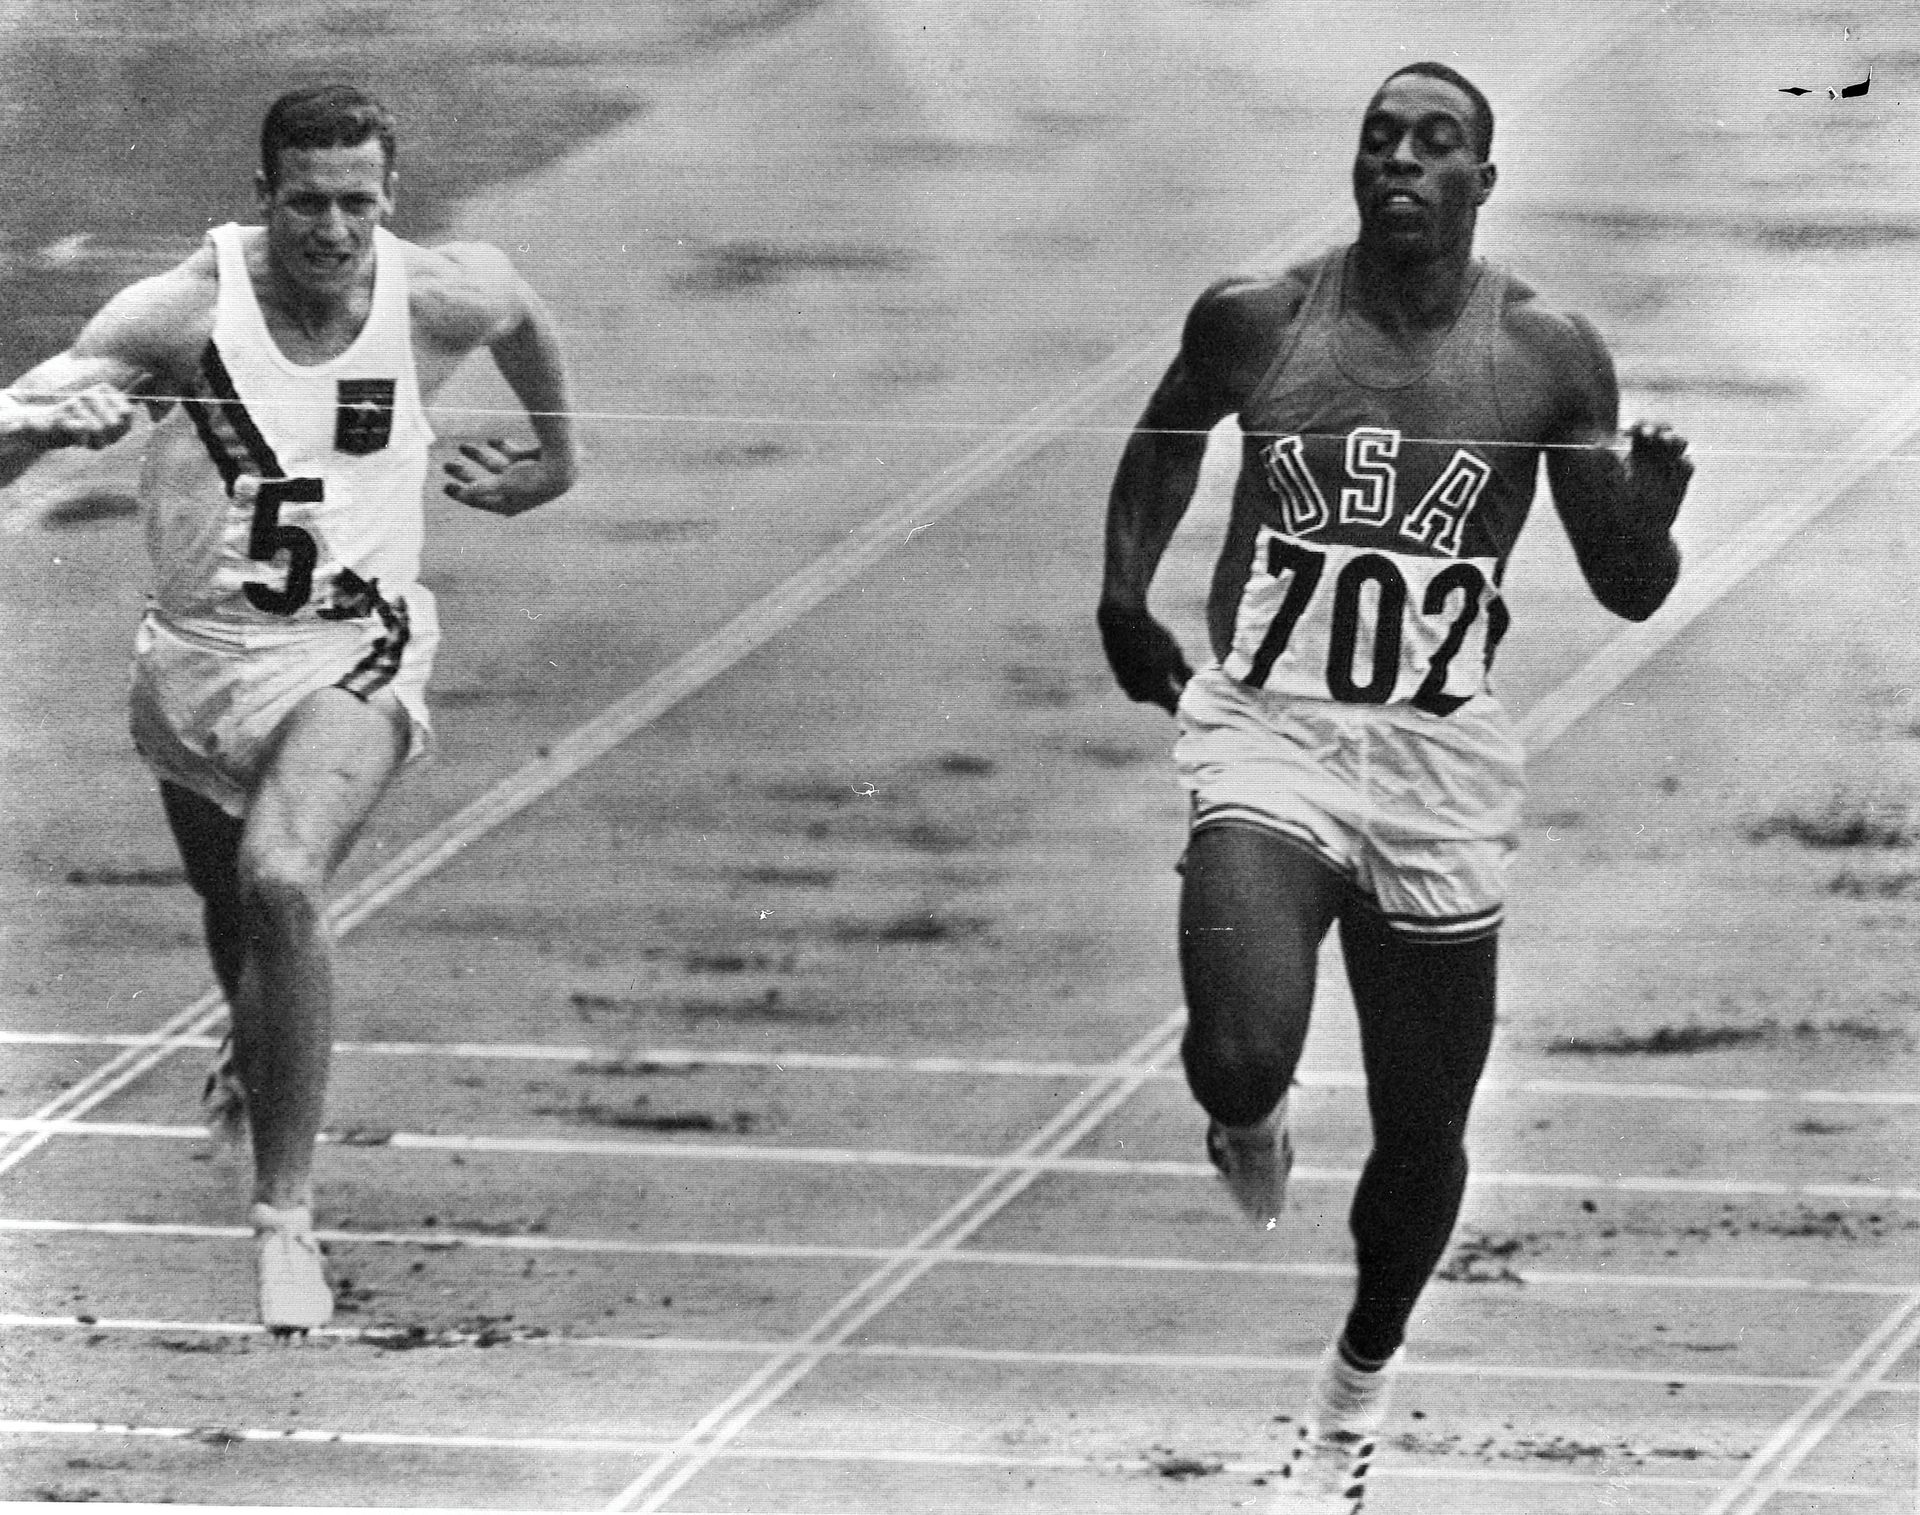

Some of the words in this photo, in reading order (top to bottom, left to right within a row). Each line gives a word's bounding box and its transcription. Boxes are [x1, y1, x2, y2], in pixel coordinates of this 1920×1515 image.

[243, 478, 324, 616] 5
[1263, 427, 1491, 556] USA
[1240, 535, 1486, 717] 702
